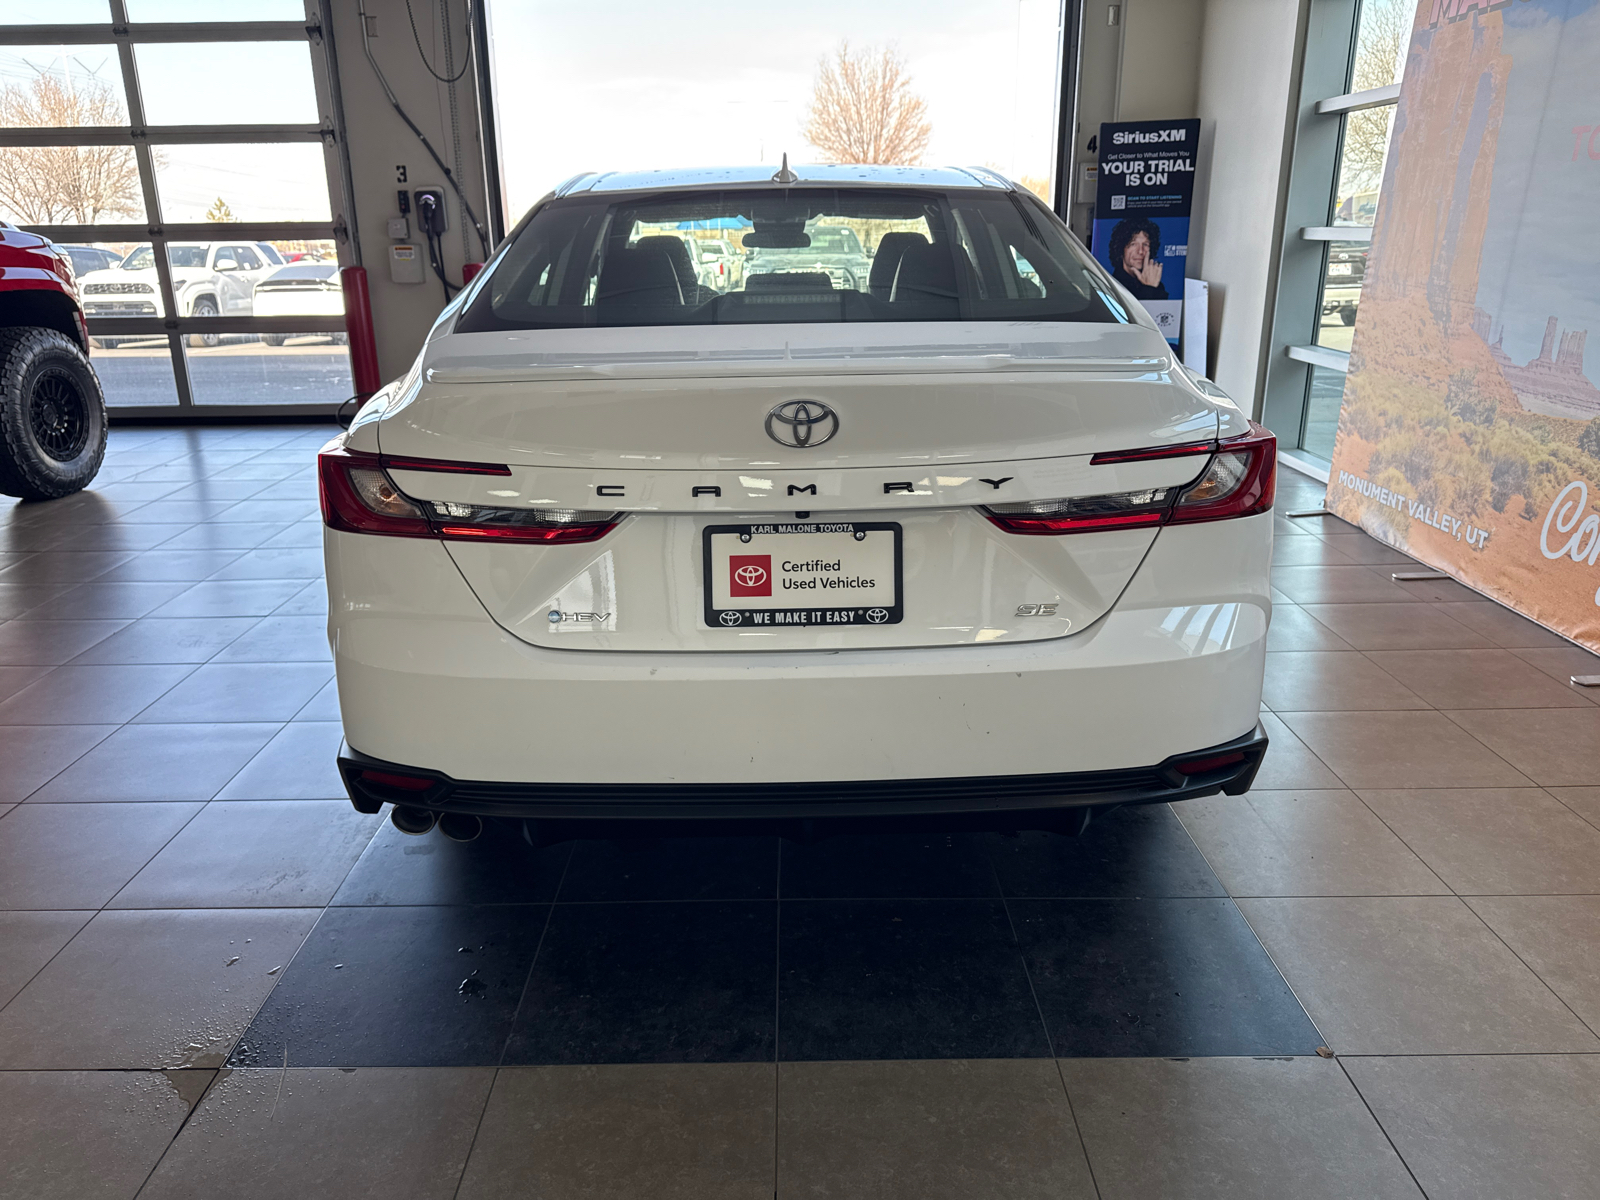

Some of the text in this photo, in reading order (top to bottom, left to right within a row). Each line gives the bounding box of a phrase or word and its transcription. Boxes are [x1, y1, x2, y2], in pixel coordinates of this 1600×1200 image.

[1112, 129, 1186, 145] SiriusXM
[1087, 135, 1097, 154] 4
[396, 165, 407, 183] 3
[1101, 161, 1145, 175] YOUR
[1148, 159, 1195, 173] TRIAL
[1125, 173, 1168, 187] IS ON
[596, 476, 1014, 498] CAMRY
[1338, 470, 1489, 549] MONUMENT VALLEY, UT
[750, 523, 854, 534] KARL MALONE TOYOTA
[781, 559, 841, 573] Certified
[782, 576, 876, 590] Used Vehicles
[562, 611, 612, 623] HEV
[1014, 603, 1059, 617] SE
[753, 611, 855, 624] WE MAKE IT EASY
